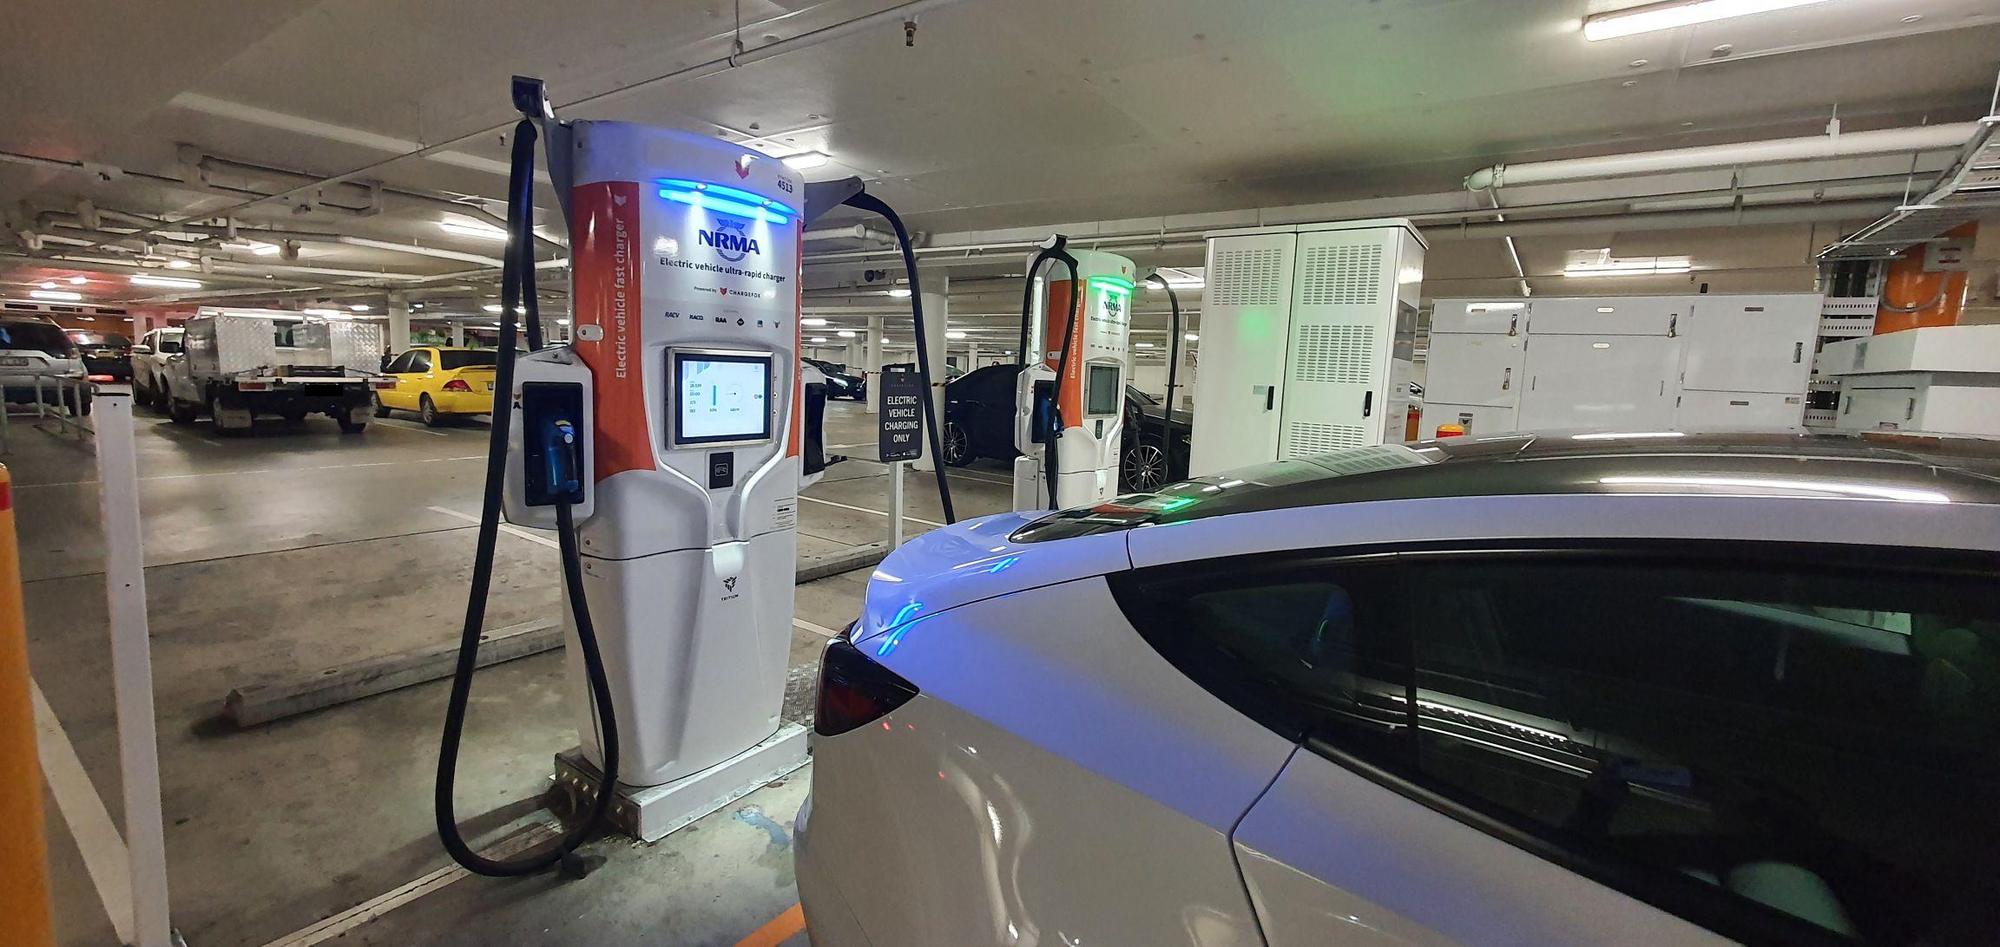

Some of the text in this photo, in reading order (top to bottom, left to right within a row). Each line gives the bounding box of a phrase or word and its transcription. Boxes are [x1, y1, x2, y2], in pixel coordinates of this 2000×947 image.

[778, 180, 792, 193] 4513
[699, 229, 760, 255] NRMA
[660, 257, 786, 283] Electric vehicle ultra-rapid charger
[614, 218, 628, 379] Electric vehicle fast charger
[715, 316, 727, 324] RAA
[887, 396, 917, 405] ELECTRIC
[889, 408, 915, 418] VEHICLE
[884, 421, 918, 430] CHARGING
[893, 434, 910, 443] ONLY
